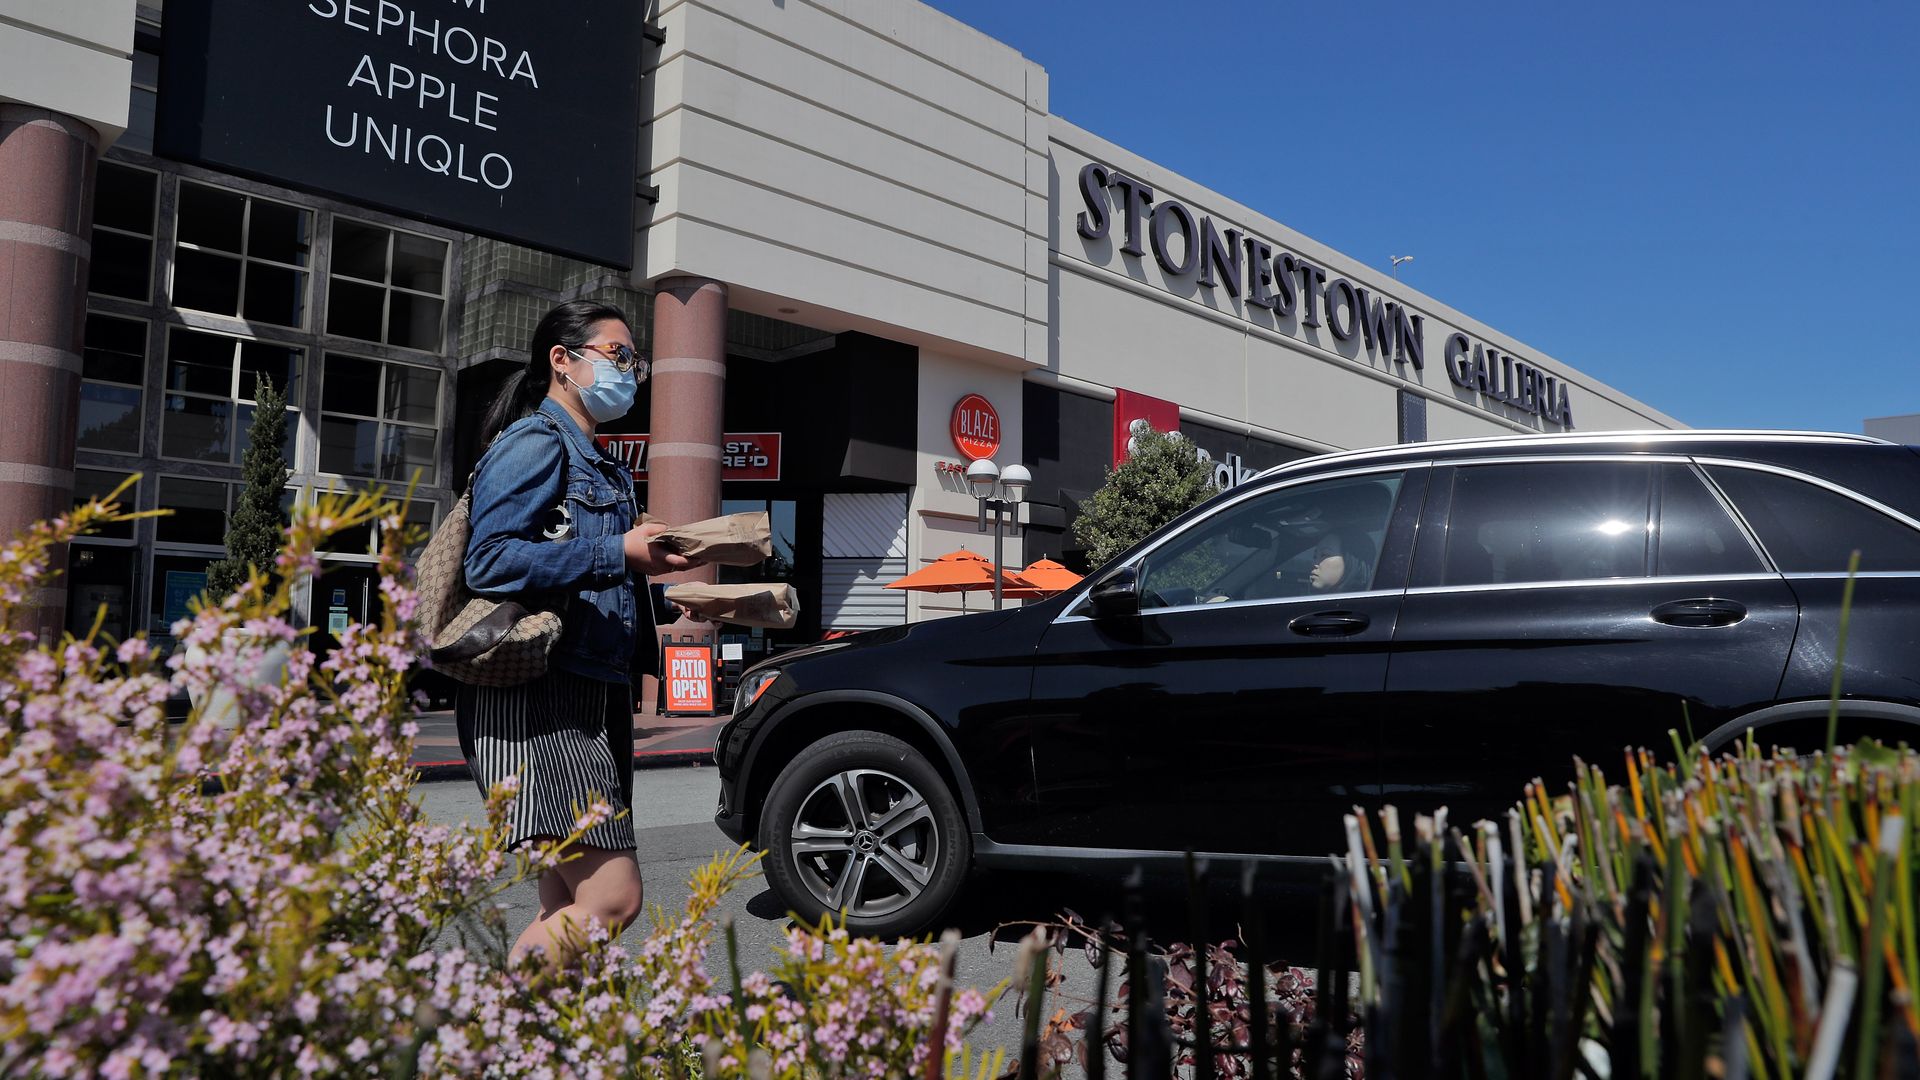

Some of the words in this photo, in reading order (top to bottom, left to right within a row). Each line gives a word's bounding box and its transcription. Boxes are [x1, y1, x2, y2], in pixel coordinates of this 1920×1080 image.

[347, 54, 499, 131] APPLE
[325, 104, 513, 190] UNIQLO
[1077, 162, 1425, 371] STONESTOWN
[1444, 332, 1576, 430] GALLERIA
[961, 409, 994, 439] BLAZE
[963, 437, 993, 448] PIZZA
[672, 659, 707, 678] PATIO
[672, 679, 708, 698] OPEN
